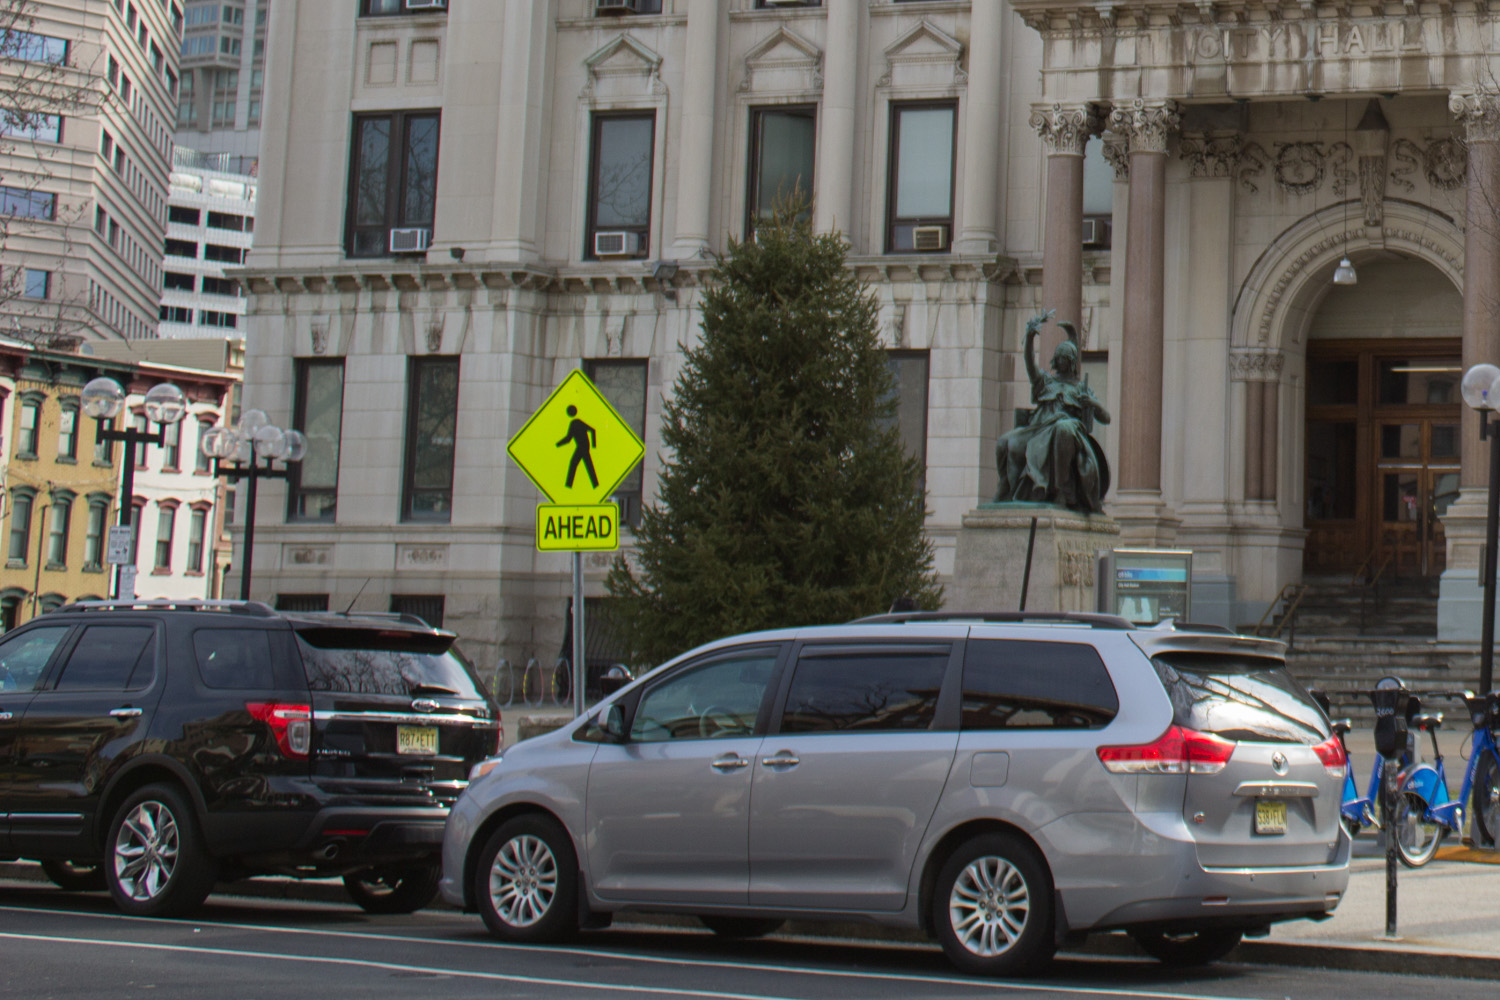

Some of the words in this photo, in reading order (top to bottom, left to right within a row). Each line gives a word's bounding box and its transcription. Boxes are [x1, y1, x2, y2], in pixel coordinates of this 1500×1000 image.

[1200, 27, 1285, 59] CITY
[1317, 22, 1422, 54] HALL
[544, 515, 612, 540] AHEAD
